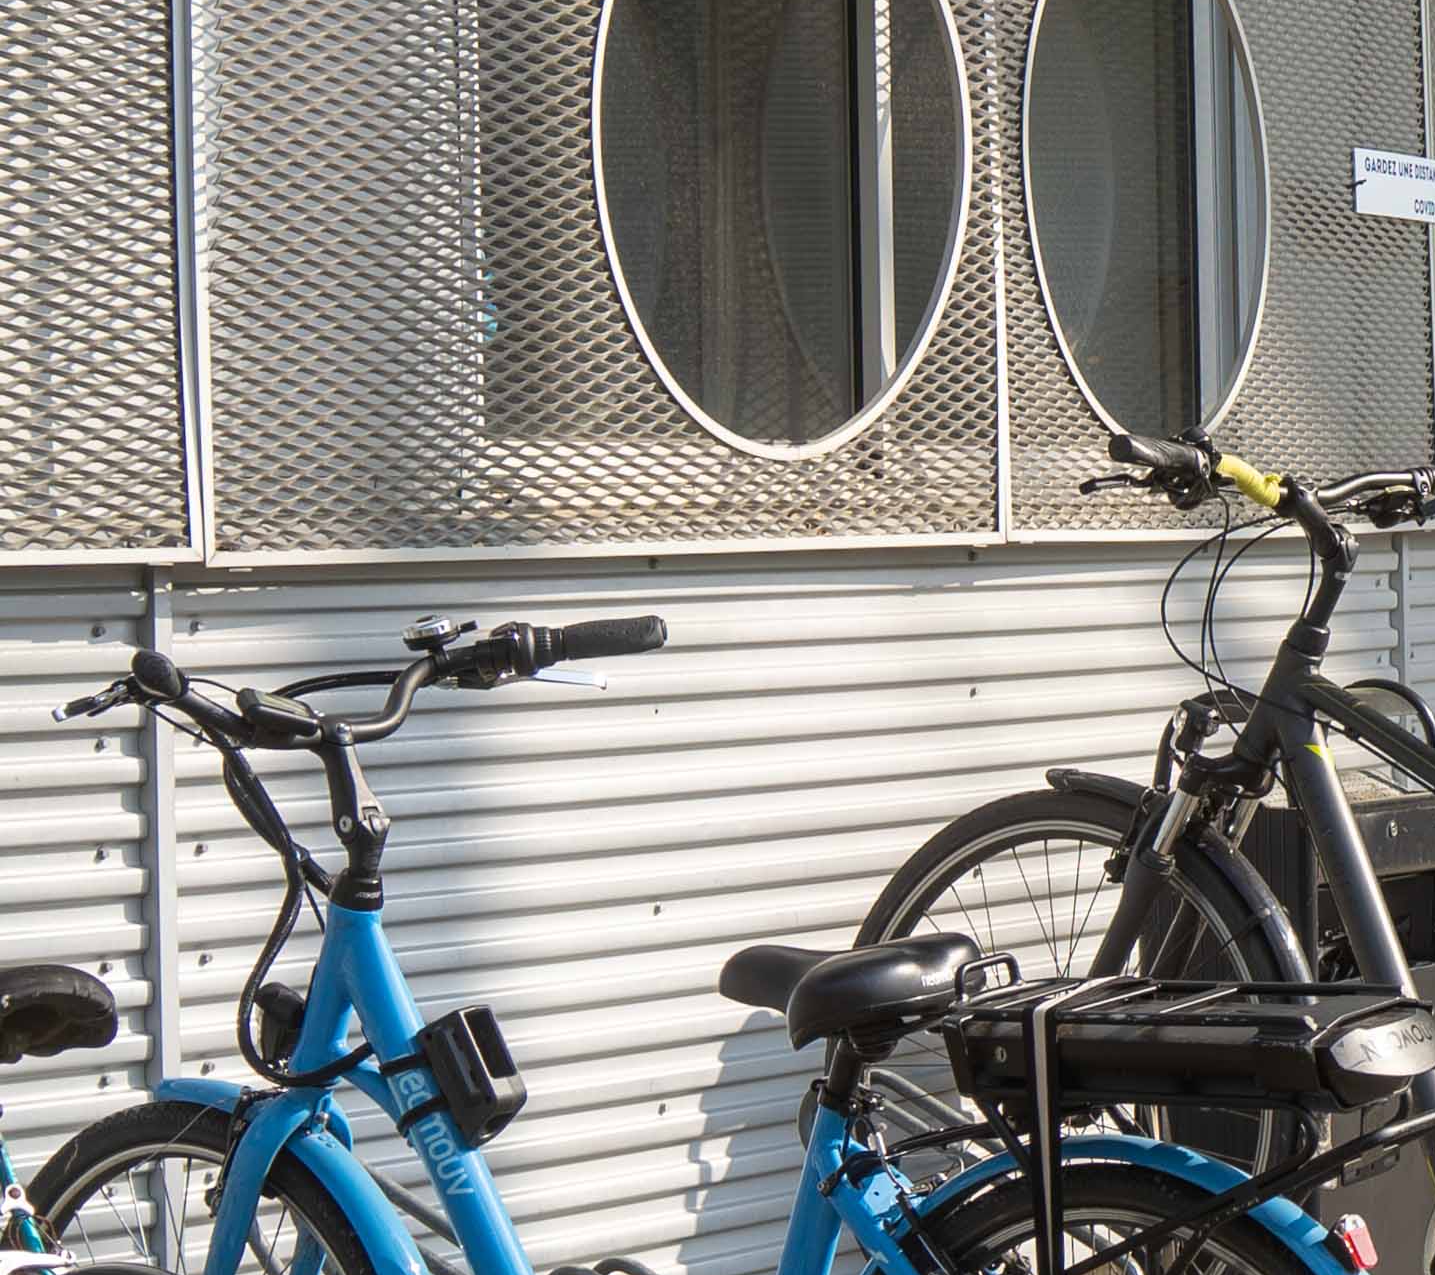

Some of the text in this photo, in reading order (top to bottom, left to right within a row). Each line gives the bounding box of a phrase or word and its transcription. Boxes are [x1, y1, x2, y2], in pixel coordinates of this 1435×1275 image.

[1364, 156, 1397, 176] GARDEZ
[1398, 162, 1413, 178] UNE
[1414, 198, 1435, 216] COVID
